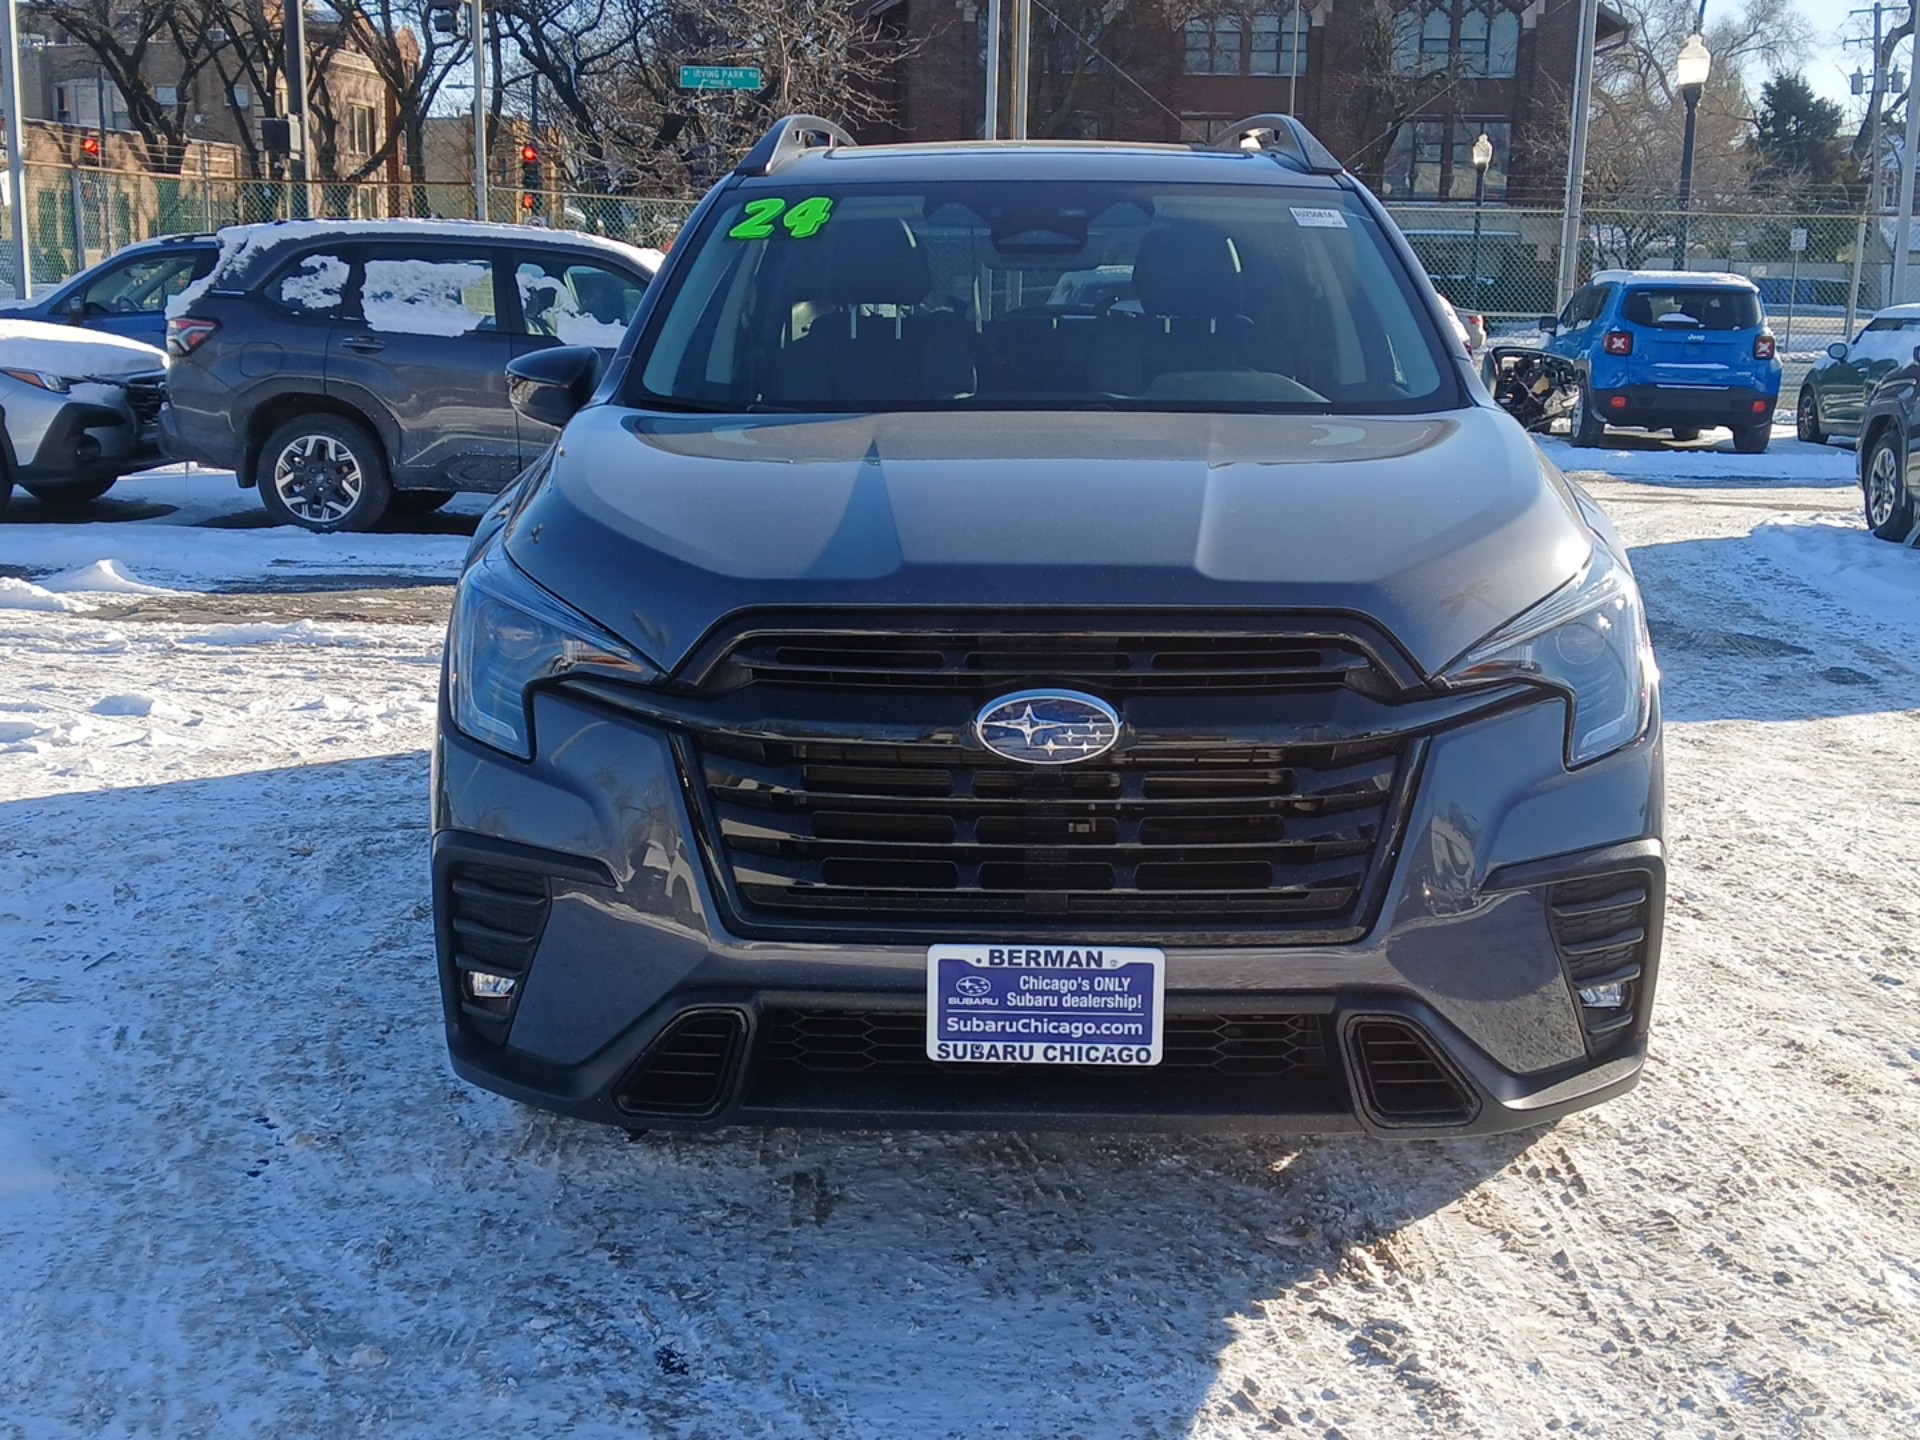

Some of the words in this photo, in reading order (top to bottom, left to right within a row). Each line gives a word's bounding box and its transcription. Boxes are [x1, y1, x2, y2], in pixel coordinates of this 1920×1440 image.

[693, 69, 720, 78] IRVING
[722, 70, 745, 79] PARK
[729, 197, 833, 238] 24
[988, 949, 1103, 968] BERMAN
[1019, 975, 1090, 994] Chicago's
[1094, 977, 1131, 992] ONLY
[947, 996, 999, 1006] SUBARU
[1006, 992, 1058, 1007] Subaru
[1062, 993, 1142, 1011] dealership!
[946, 1017, 1143, 1038] SubaruChicago.com
[936, 1043, 1034, 1060] SUBARU
[1043, 1046, 1152, 1064] CHICAGO
